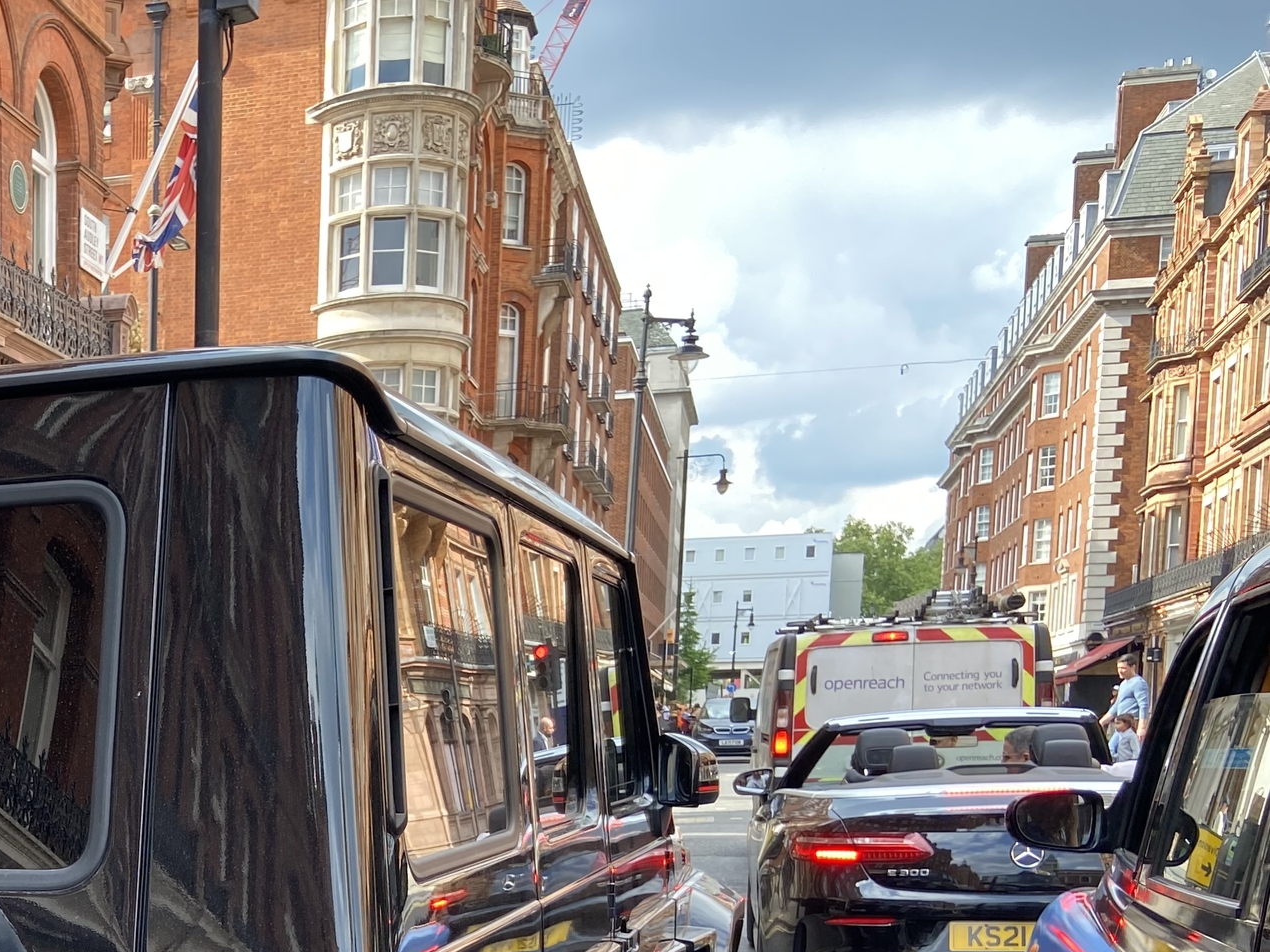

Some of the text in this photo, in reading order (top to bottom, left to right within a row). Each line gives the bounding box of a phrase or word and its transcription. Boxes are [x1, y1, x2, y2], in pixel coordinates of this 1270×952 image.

[923, 670, 1003, 682] Connecting you
[824, 676, 905, 692] openreach
[924, 680, 1003, 694] to your network
[899, 868, 930, 876] 300
[967, 925, 1026, 947] KS21
